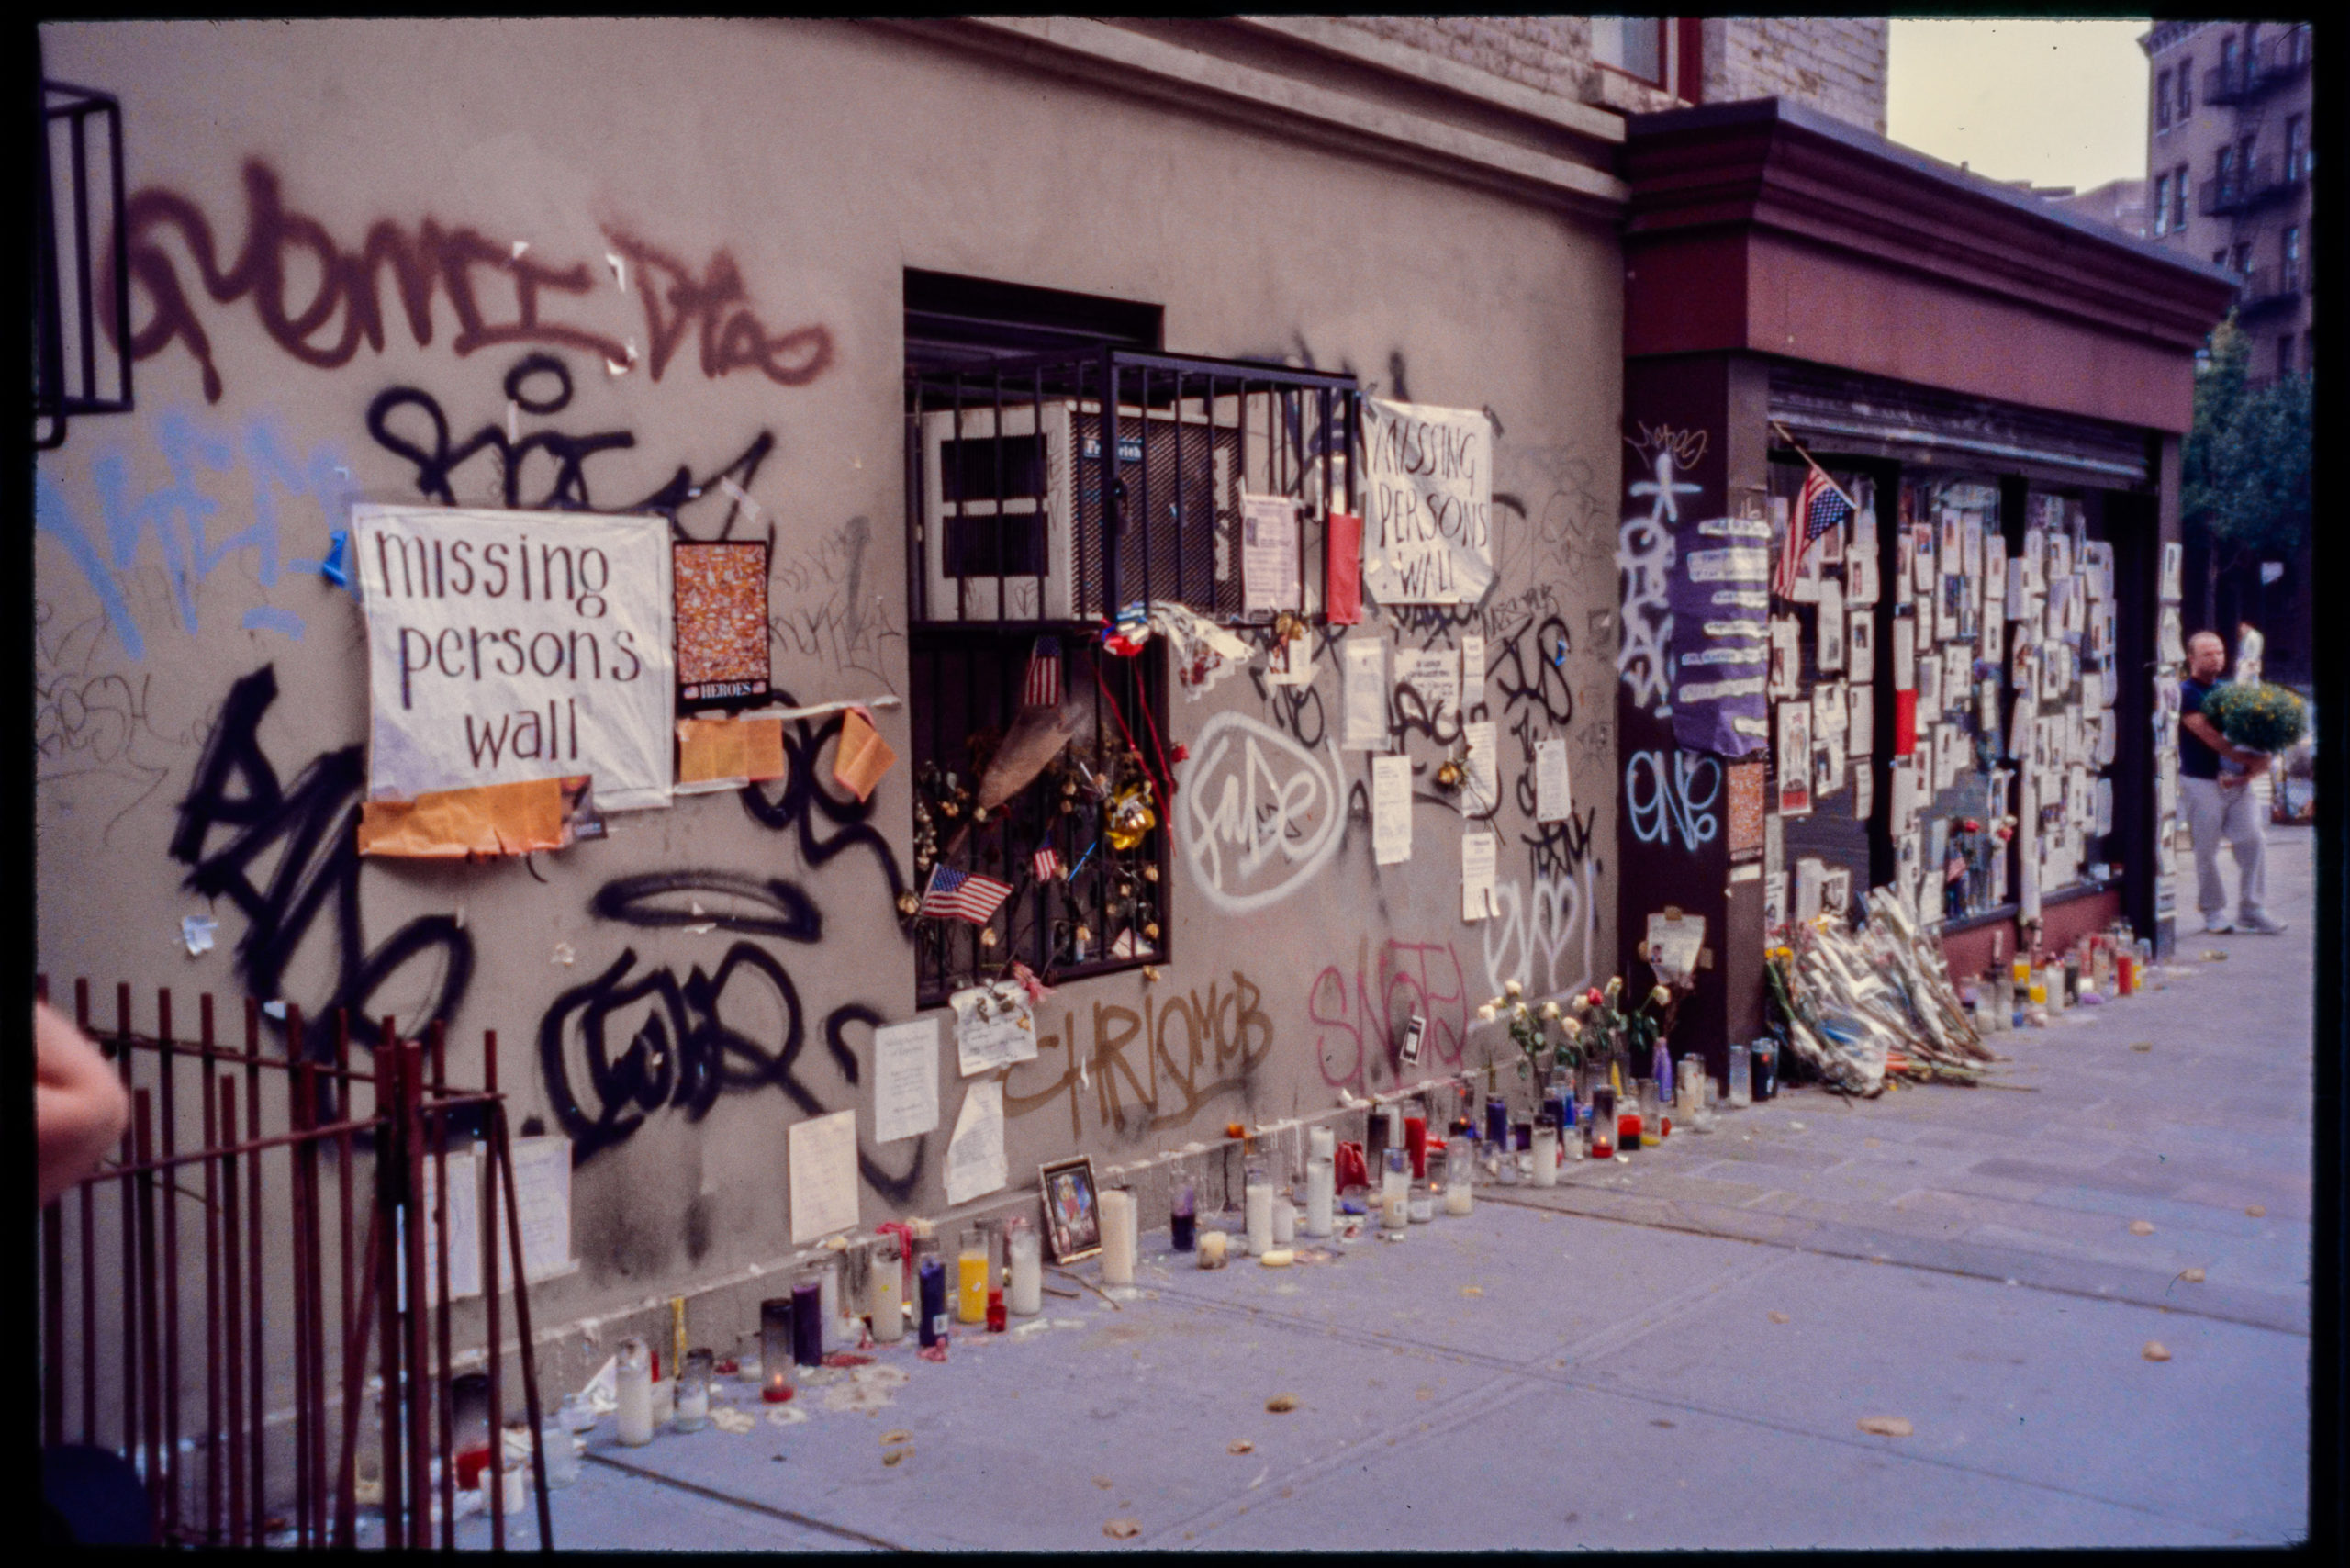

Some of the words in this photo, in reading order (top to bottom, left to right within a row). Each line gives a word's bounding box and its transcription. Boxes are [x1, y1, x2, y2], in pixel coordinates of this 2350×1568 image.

[1372, 419, 1475, 497] MISSING
[1379, 483, 1487, 550] PERSONS
[375, 529, 609, 619] missing
[1398, 549, 1456, 598] WALL
[399, 626, 641, 711] persons
[700, 682, 752, 700] HEROES
[465, 698, 578, 769] wall
